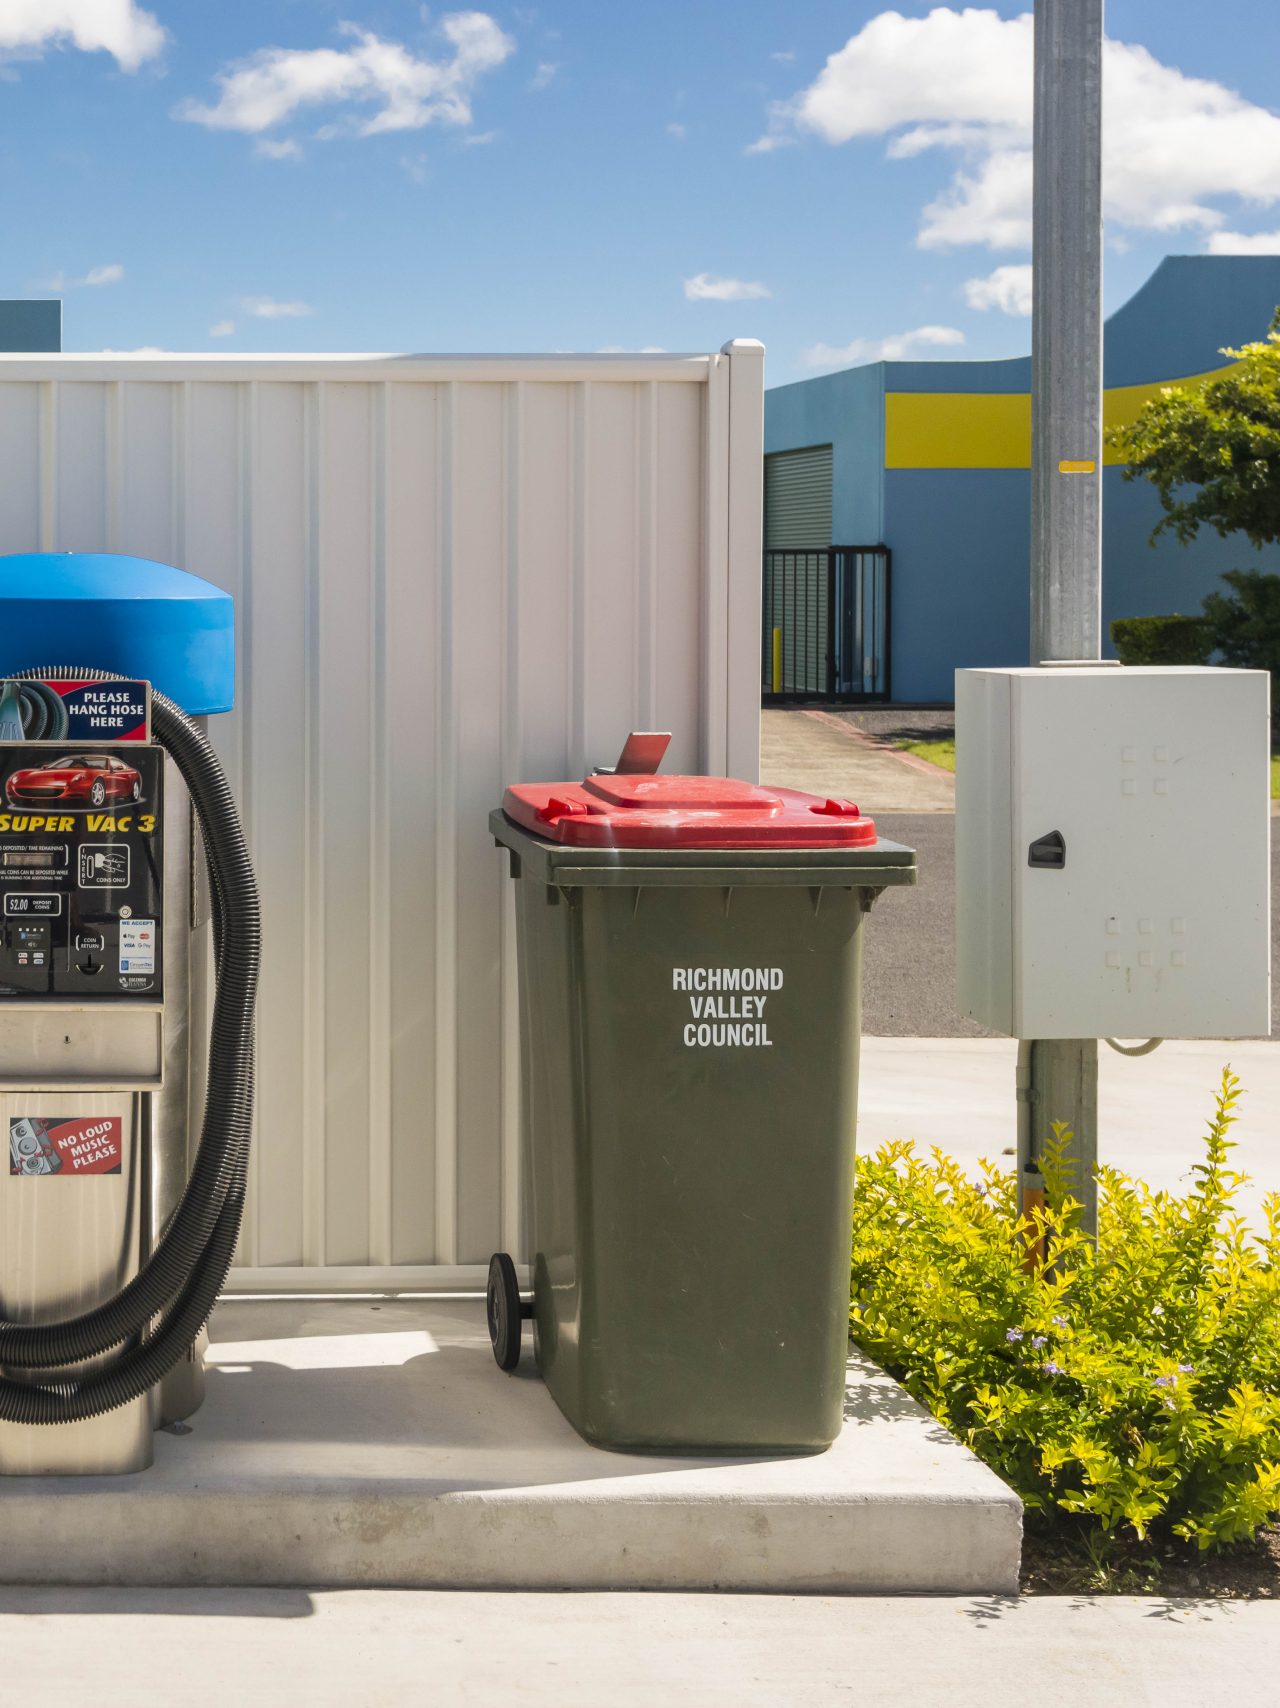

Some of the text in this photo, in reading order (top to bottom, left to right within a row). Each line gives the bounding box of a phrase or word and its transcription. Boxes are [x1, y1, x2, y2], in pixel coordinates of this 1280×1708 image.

[84, 692, 130, 703] PLEASE
[69, 704, 144, 715] HANG HOSE
[90, 717, 124, 727] HERE
[86, 814, 132, 832] VAC
[137, 815, 156, 832] 3
[10, 898, 28, 911] $2.00
[672, 967, 784, 991] RICHMOND
[689, 996, 767, 1018] VALLEY
[683, 1023, 773, 1047] COUNCIL
[57, 1121, 113, 1149] NO LOUD
[70, 1134, 110, 1157] MUSIC
[72, 1144, 117, 1169] PLEASE
